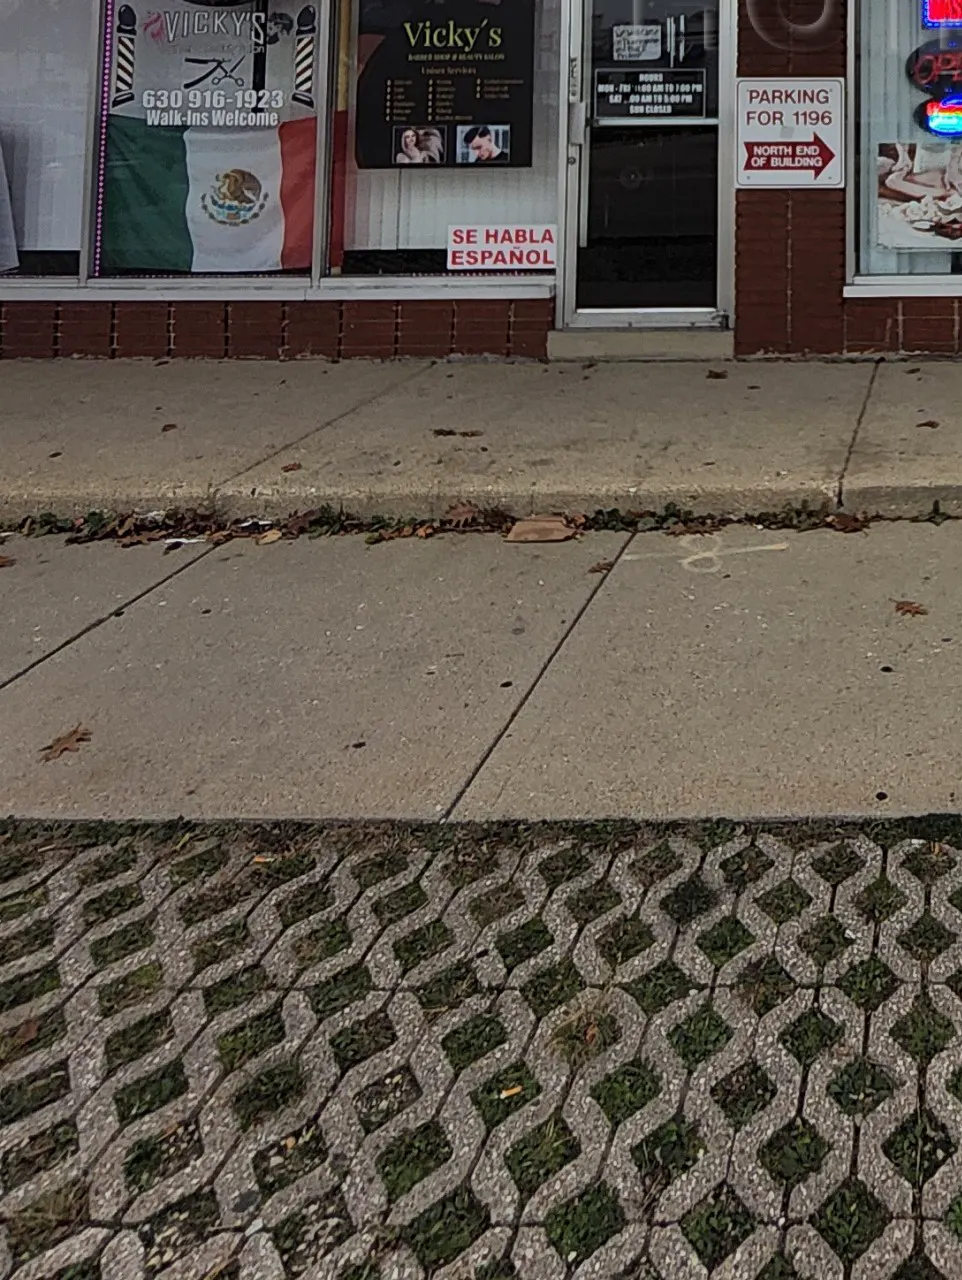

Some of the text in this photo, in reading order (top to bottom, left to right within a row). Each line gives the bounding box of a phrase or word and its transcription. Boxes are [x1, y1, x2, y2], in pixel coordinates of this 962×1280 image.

[164, 10, 266, 45] VICKY'S
[142, 90, 284, 109] 630 916-1923
[749, 89, 830, 105] PARKING
[645, 105, 672, 114] CLOSED
[146, 110, 279, 126] Walk-Ins Welcome
[746, 111, 833, 126] FOR 1196
[753, 146, 820, 156] NORTH END
[751, 157, 823, 167] OF BUILDING
[452, 228, 555, 244] SE HABLA
[451, 246, 555, 265] ESPAÑOL
